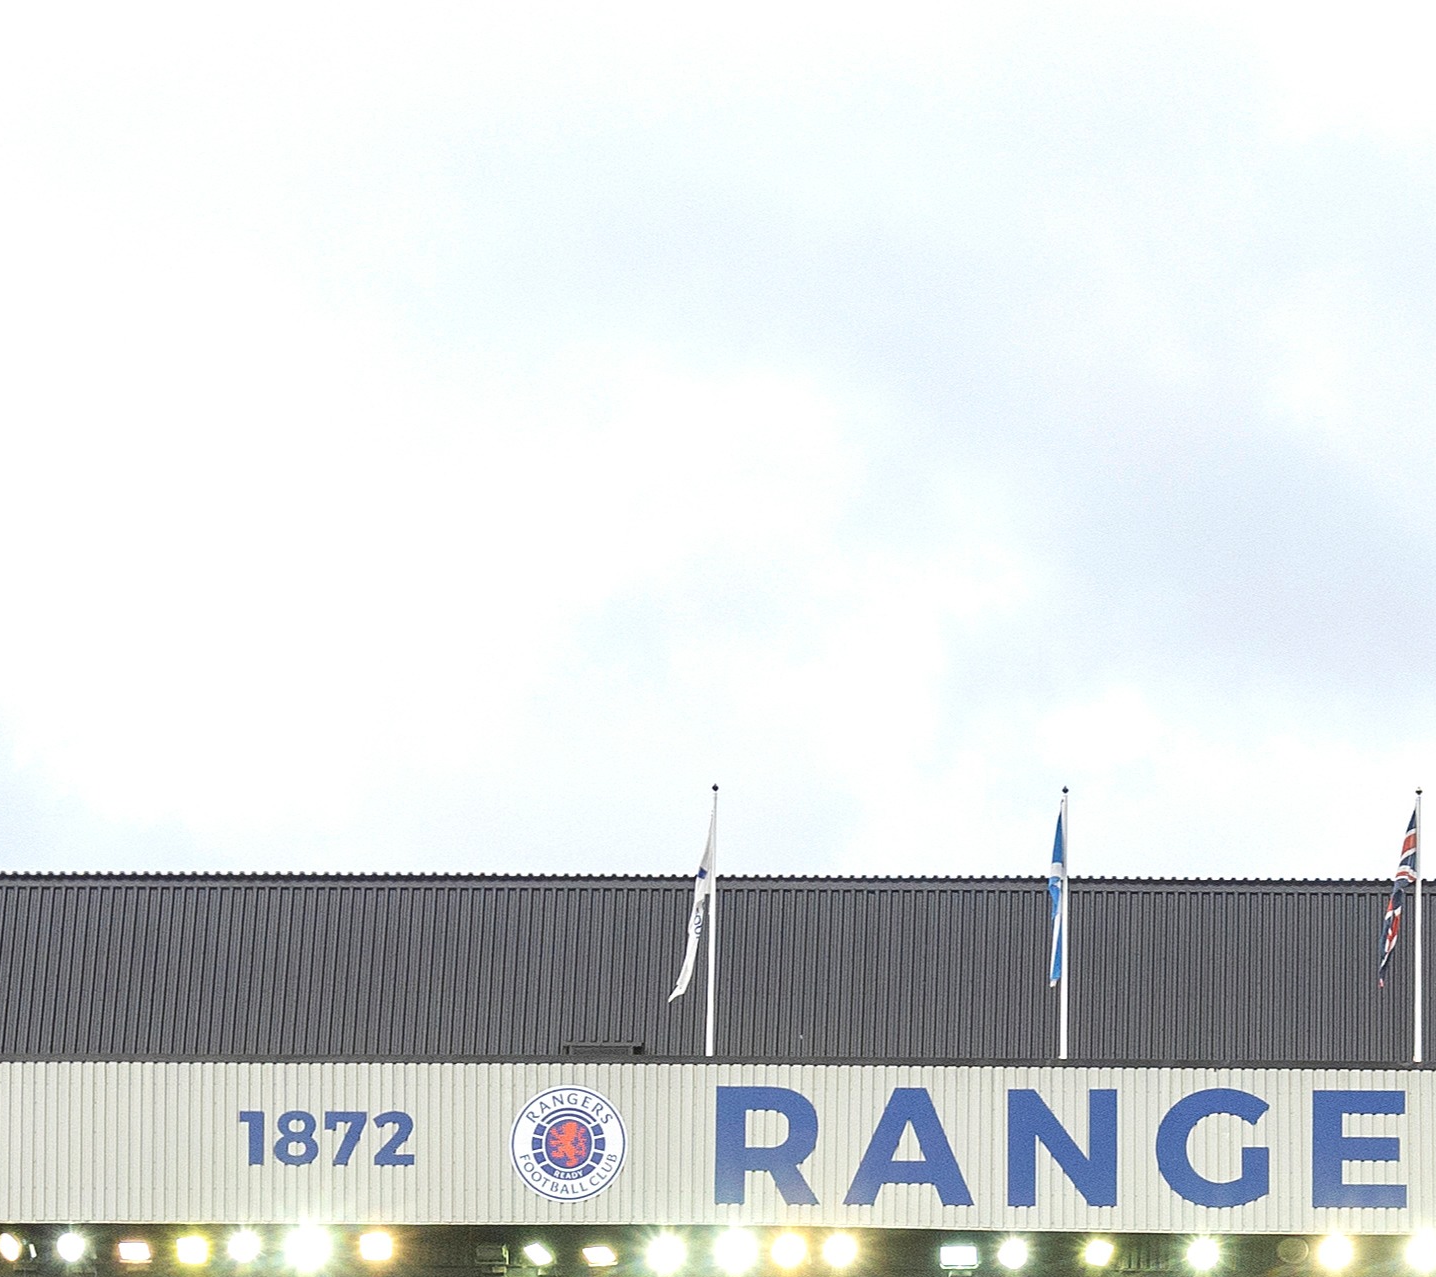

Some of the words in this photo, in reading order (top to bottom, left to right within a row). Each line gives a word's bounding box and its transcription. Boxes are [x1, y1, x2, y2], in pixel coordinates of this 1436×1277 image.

[525, 1093, 614, 1124] RANGERS
[239, 1110, 415, 1167] 1872
[519, 1153, 588, 1194] FOOTBALL
[589, 1153, 618, 1186] CLUB
[553, 1170, 584, 1179] READY
